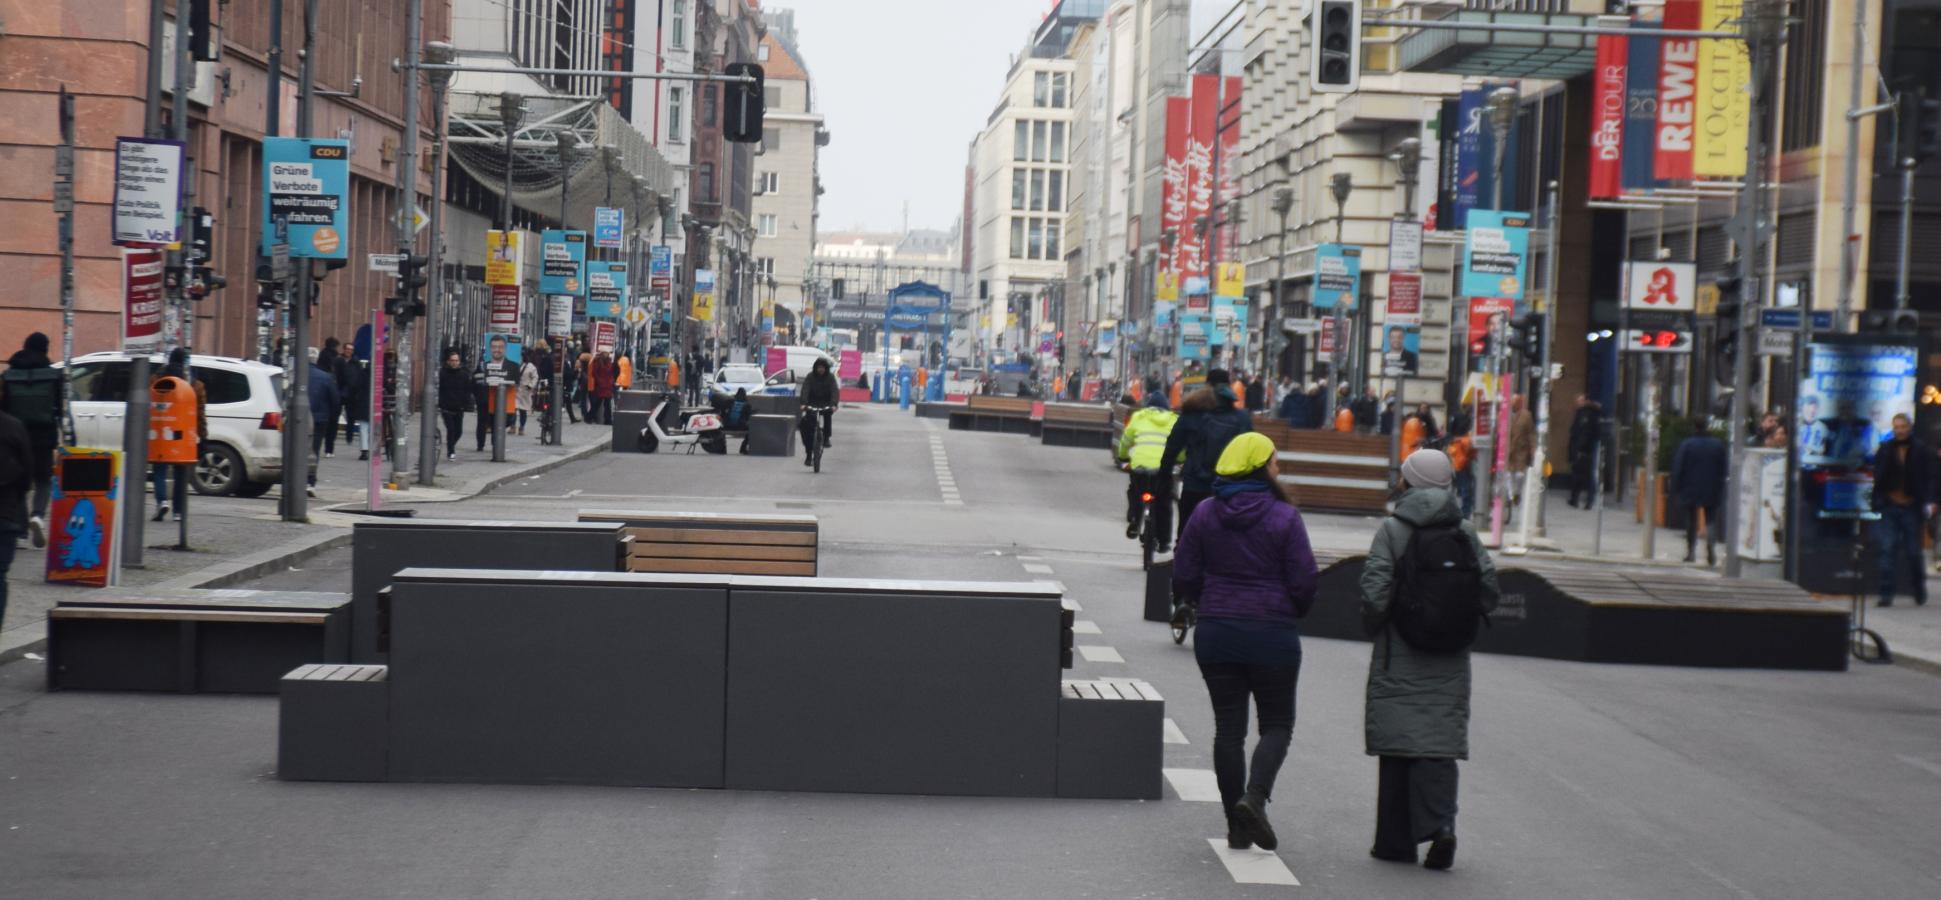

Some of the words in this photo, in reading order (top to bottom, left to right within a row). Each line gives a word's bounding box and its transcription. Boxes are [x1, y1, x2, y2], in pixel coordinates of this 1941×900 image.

[1660, 40, 1697, 151] REWE
[1600, 65, 1625, 160] DERTOUR
[316, 148, 341, 157] CDU
[273, 165, 309, 176] Grüne
[272, 181, 318, 191] Verbote
[272, 196, 338, 210] weiträumig
[273, 211, 332, 223] fahren.
[146, 229, 173, 241] Volt
